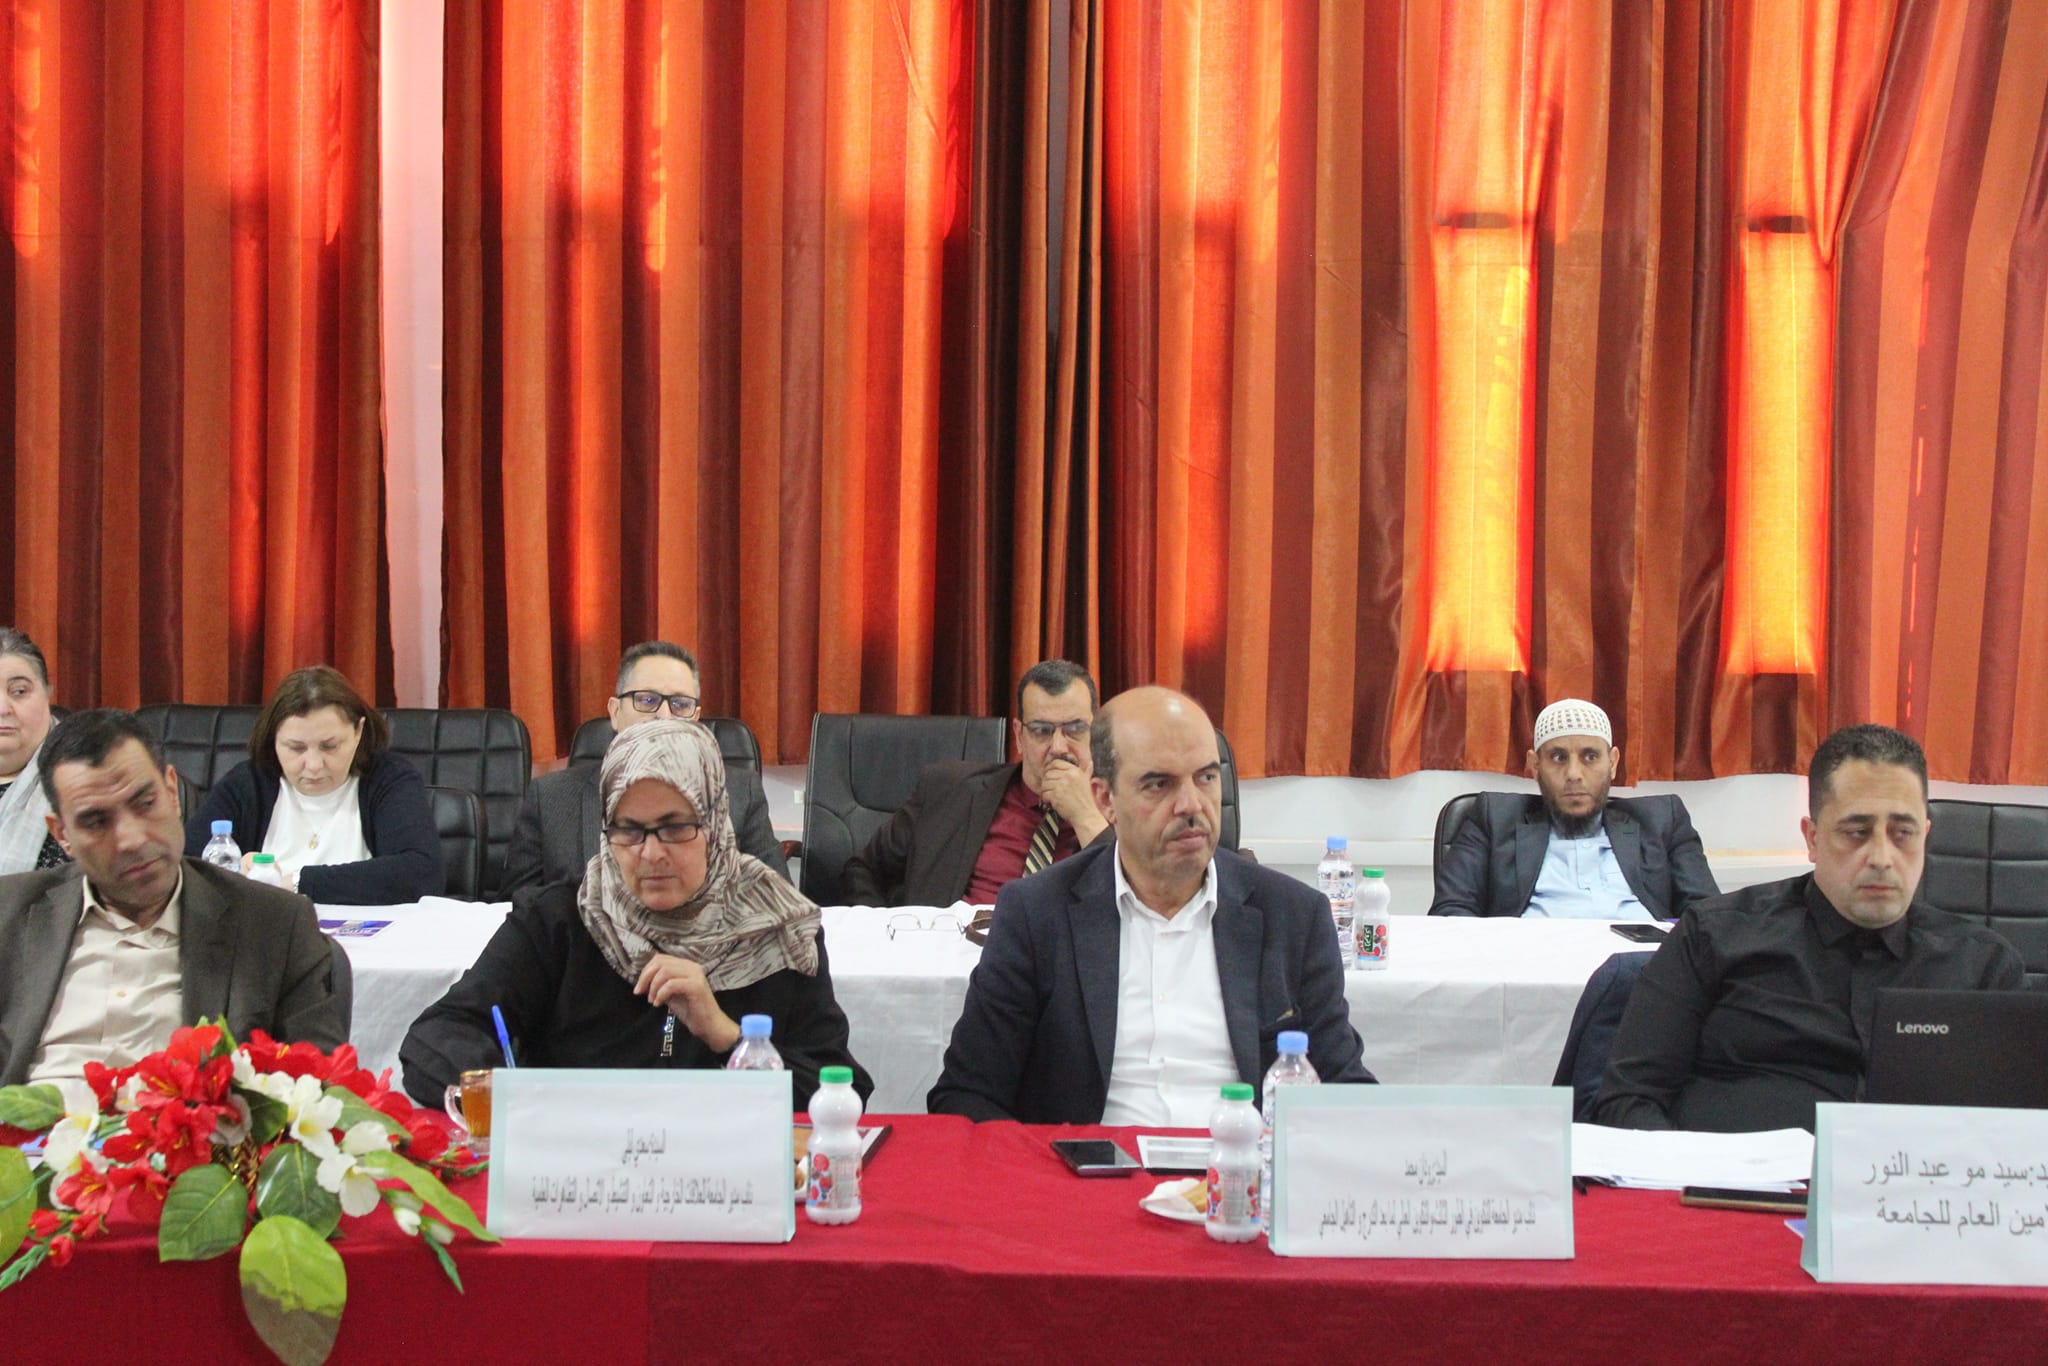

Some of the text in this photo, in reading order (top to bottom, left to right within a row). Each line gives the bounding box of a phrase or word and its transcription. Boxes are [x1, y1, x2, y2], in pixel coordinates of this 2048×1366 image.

[1896, 1021, 1950, 1035] Lenovo
[1863, 1151, 1909, 1185] النور
[1918, 1159, 1950, 1185] عبد
[1960, 1167, 1985, 1188] مو
[1876, 1197, 1951, 1231] للجامعة
[1957, 1200, 2000, 1240] العام
